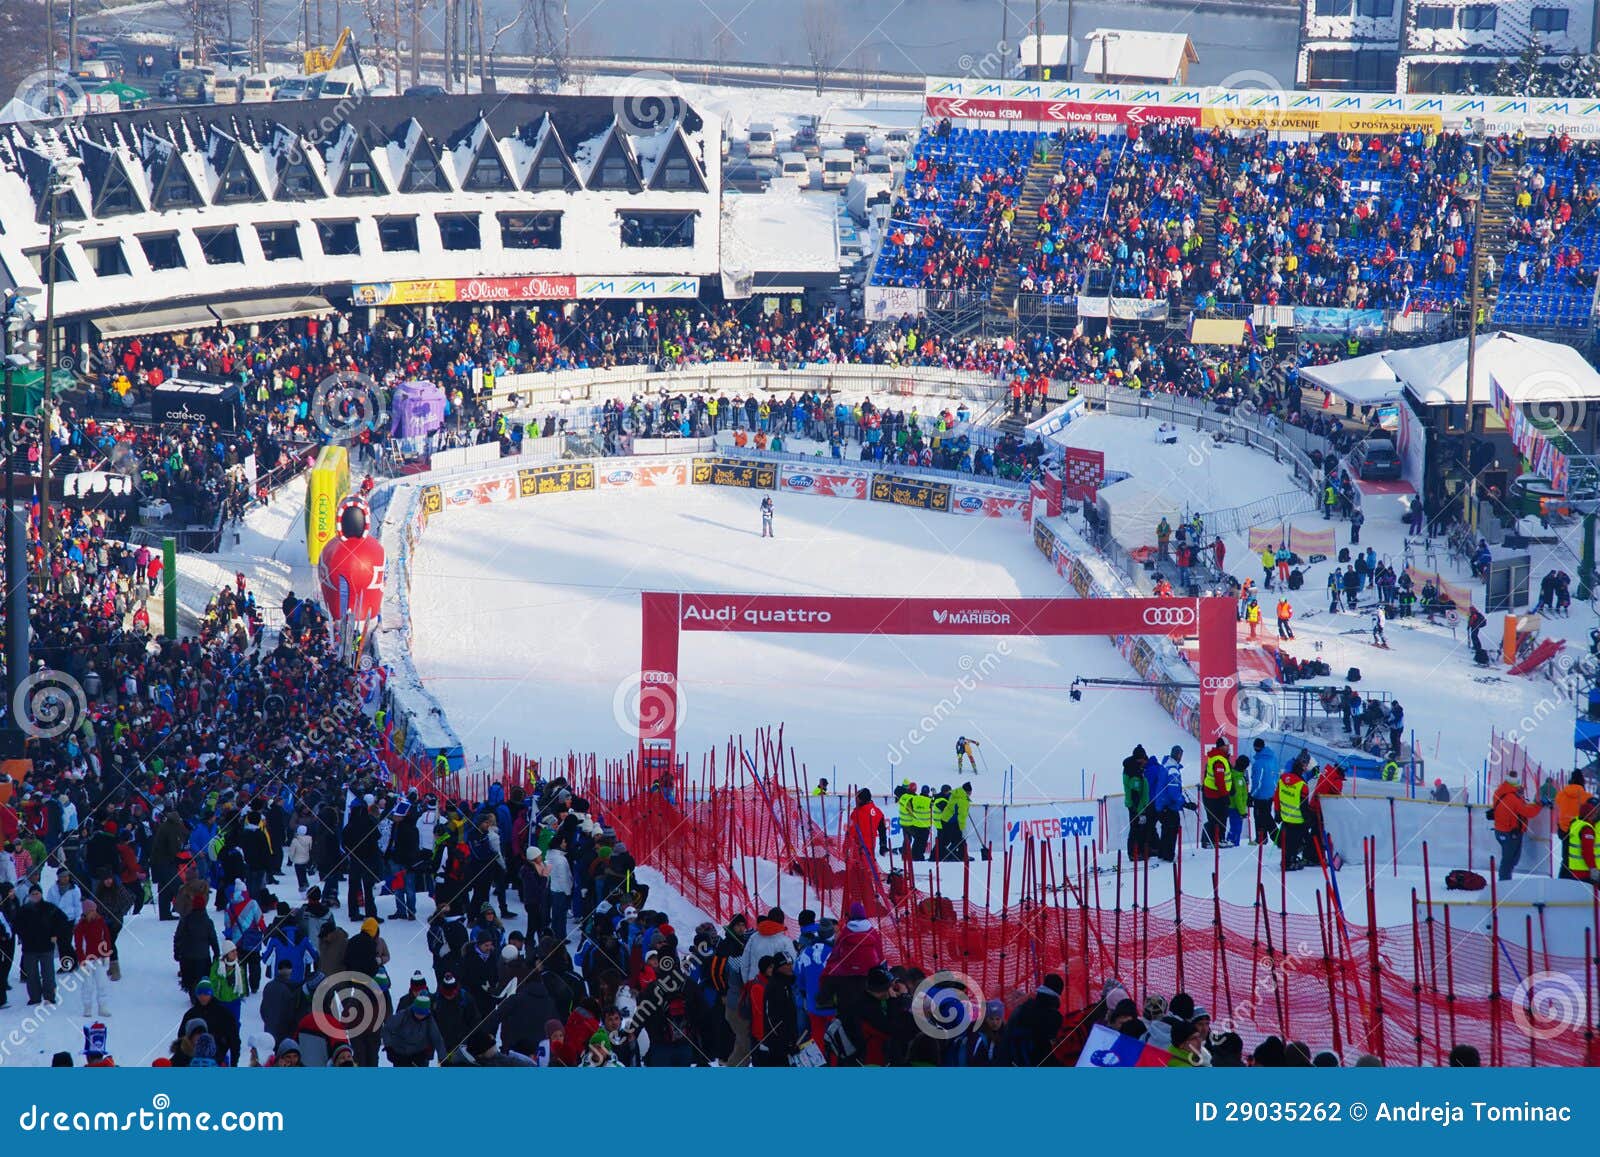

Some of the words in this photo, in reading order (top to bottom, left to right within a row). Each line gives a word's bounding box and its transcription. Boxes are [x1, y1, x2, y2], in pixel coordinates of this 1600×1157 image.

[968, 108, 996, 118] Nova
[999, 109, 1023, 119] KBM
[1066, 111, 1092, 121] Nova
[1095, 112, 1117, 121] KBM
[460, 280, 511, 299] s.Oliver
[521, 278, 571, 297] s.Oliver
[683, 605, 737, 621] Audi
[743, 607, 832, 625] quattro
[949, 613, 1011, 624] MARIBOR
[1019, 815, 1095, 841] INTERSPORT
